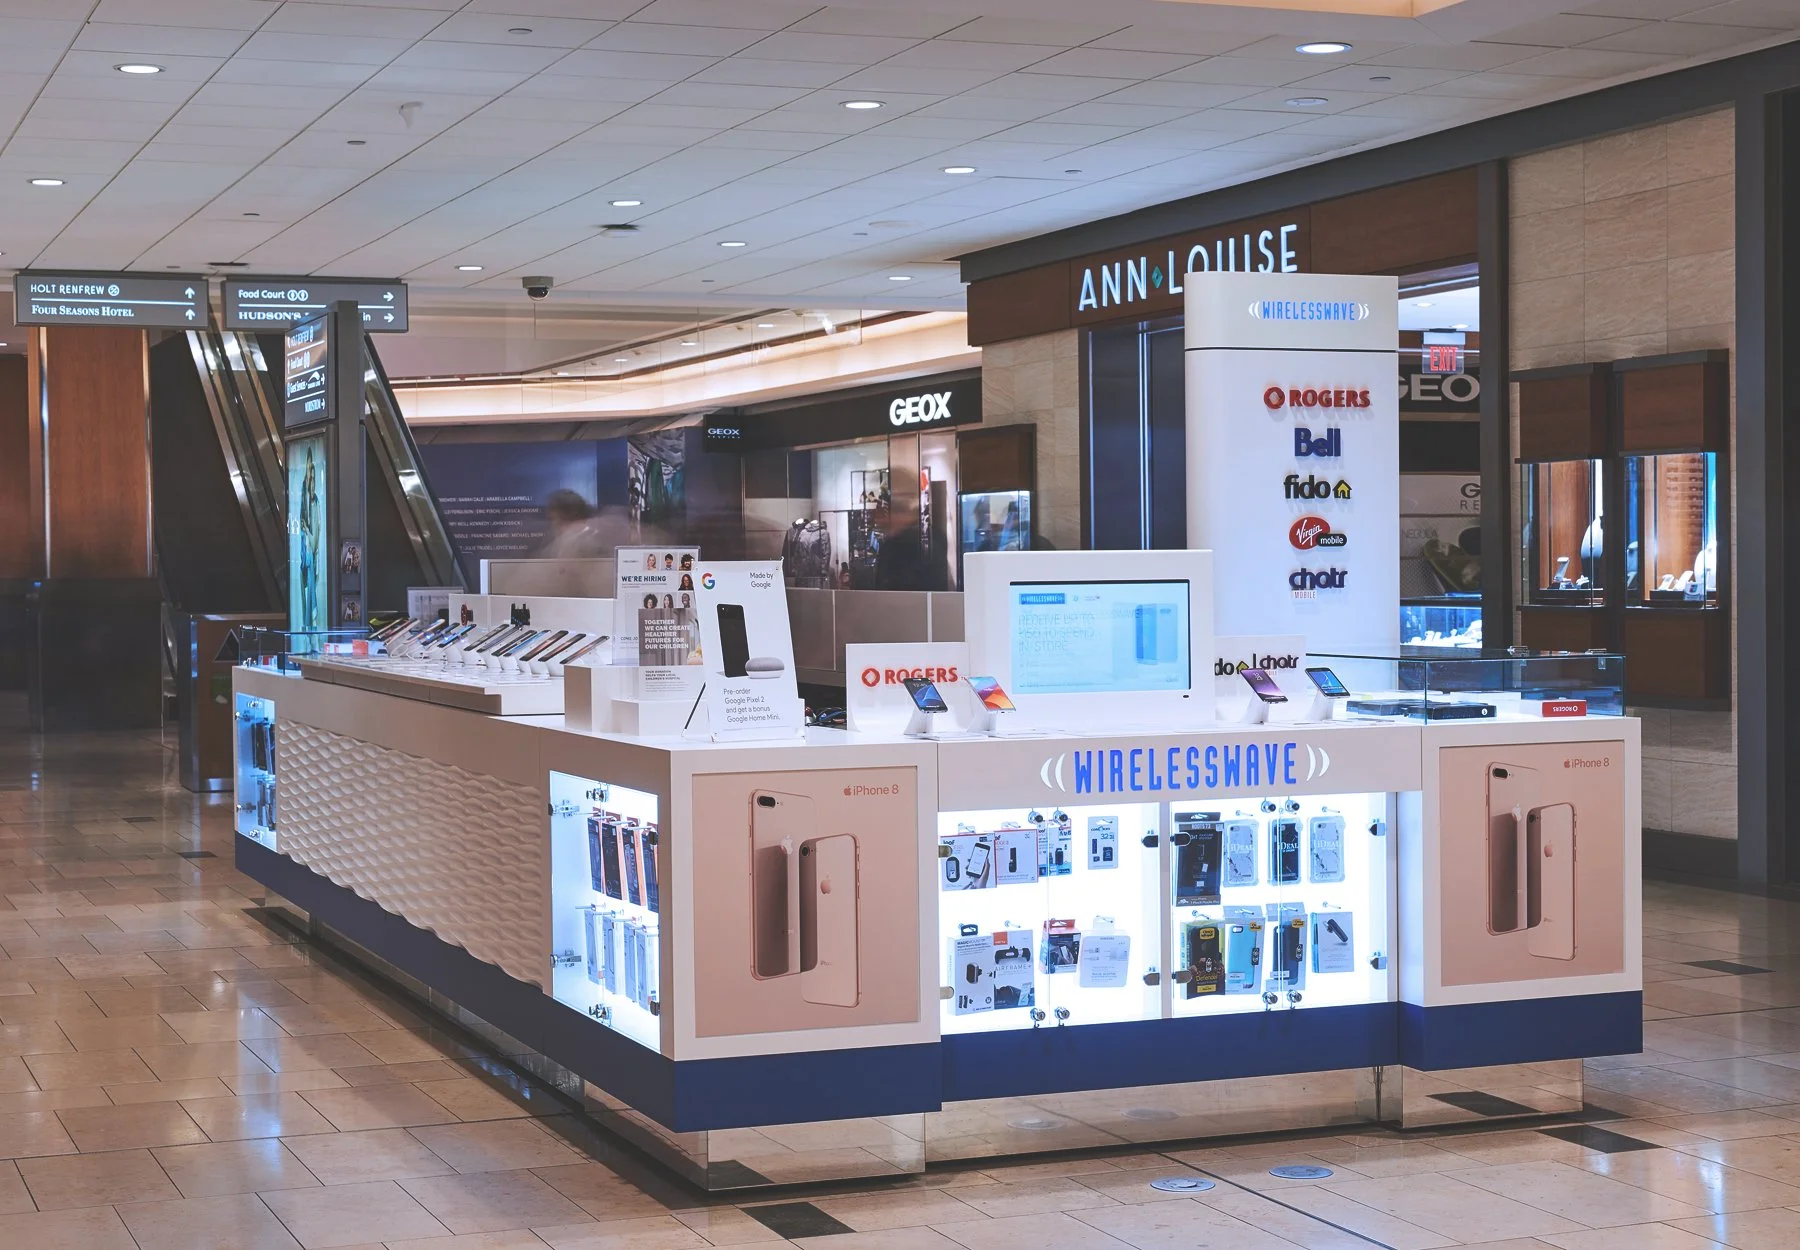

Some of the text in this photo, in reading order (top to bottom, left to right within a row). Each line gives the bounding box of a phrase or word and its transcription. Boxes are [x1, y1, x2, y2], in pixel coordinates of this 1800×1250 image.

[1079, 224, 1298, 311] ANN LOUISE
[30, 284, 105, 295] HOLT RENFREW
[238, 289, 285, 299] Food Court
[238, 311, 302, 320] HUDSON'S
[1262, 301, 1355, 320] WIRELESSWAVE
[1430, 346, 1458, 371] EXIT
[1398, 374, 1480, 402] EO
[1289, 389, 1370, 408] ROGERS
[889, 391, 952, 426] GEOX
[1294, 428, 1341, 457] Bell
[1284, 475, 1331, 499] fido
[1296, 519, 1322, 546] Virgin
[1320, 536, 1344, 544] mobile
[702, 573, 715, 590] G
[750, 581, 771, 589] Google
[1289, 568, 1348, 589] chatr
[1294, 591, 1316, 599] MOBILE
[884, 667, 958, 684] ROGERS
[1215, 658, 1235, 676] do
[725, 697, 746, 705] Google
[727, 715, 748, 723] Google
[1074, 743, 1297, 794] WIRELESSWAVE
[1571, 757, 1610, 769] iPhone 8
[853, 784, 899, 796] iPhone 8
